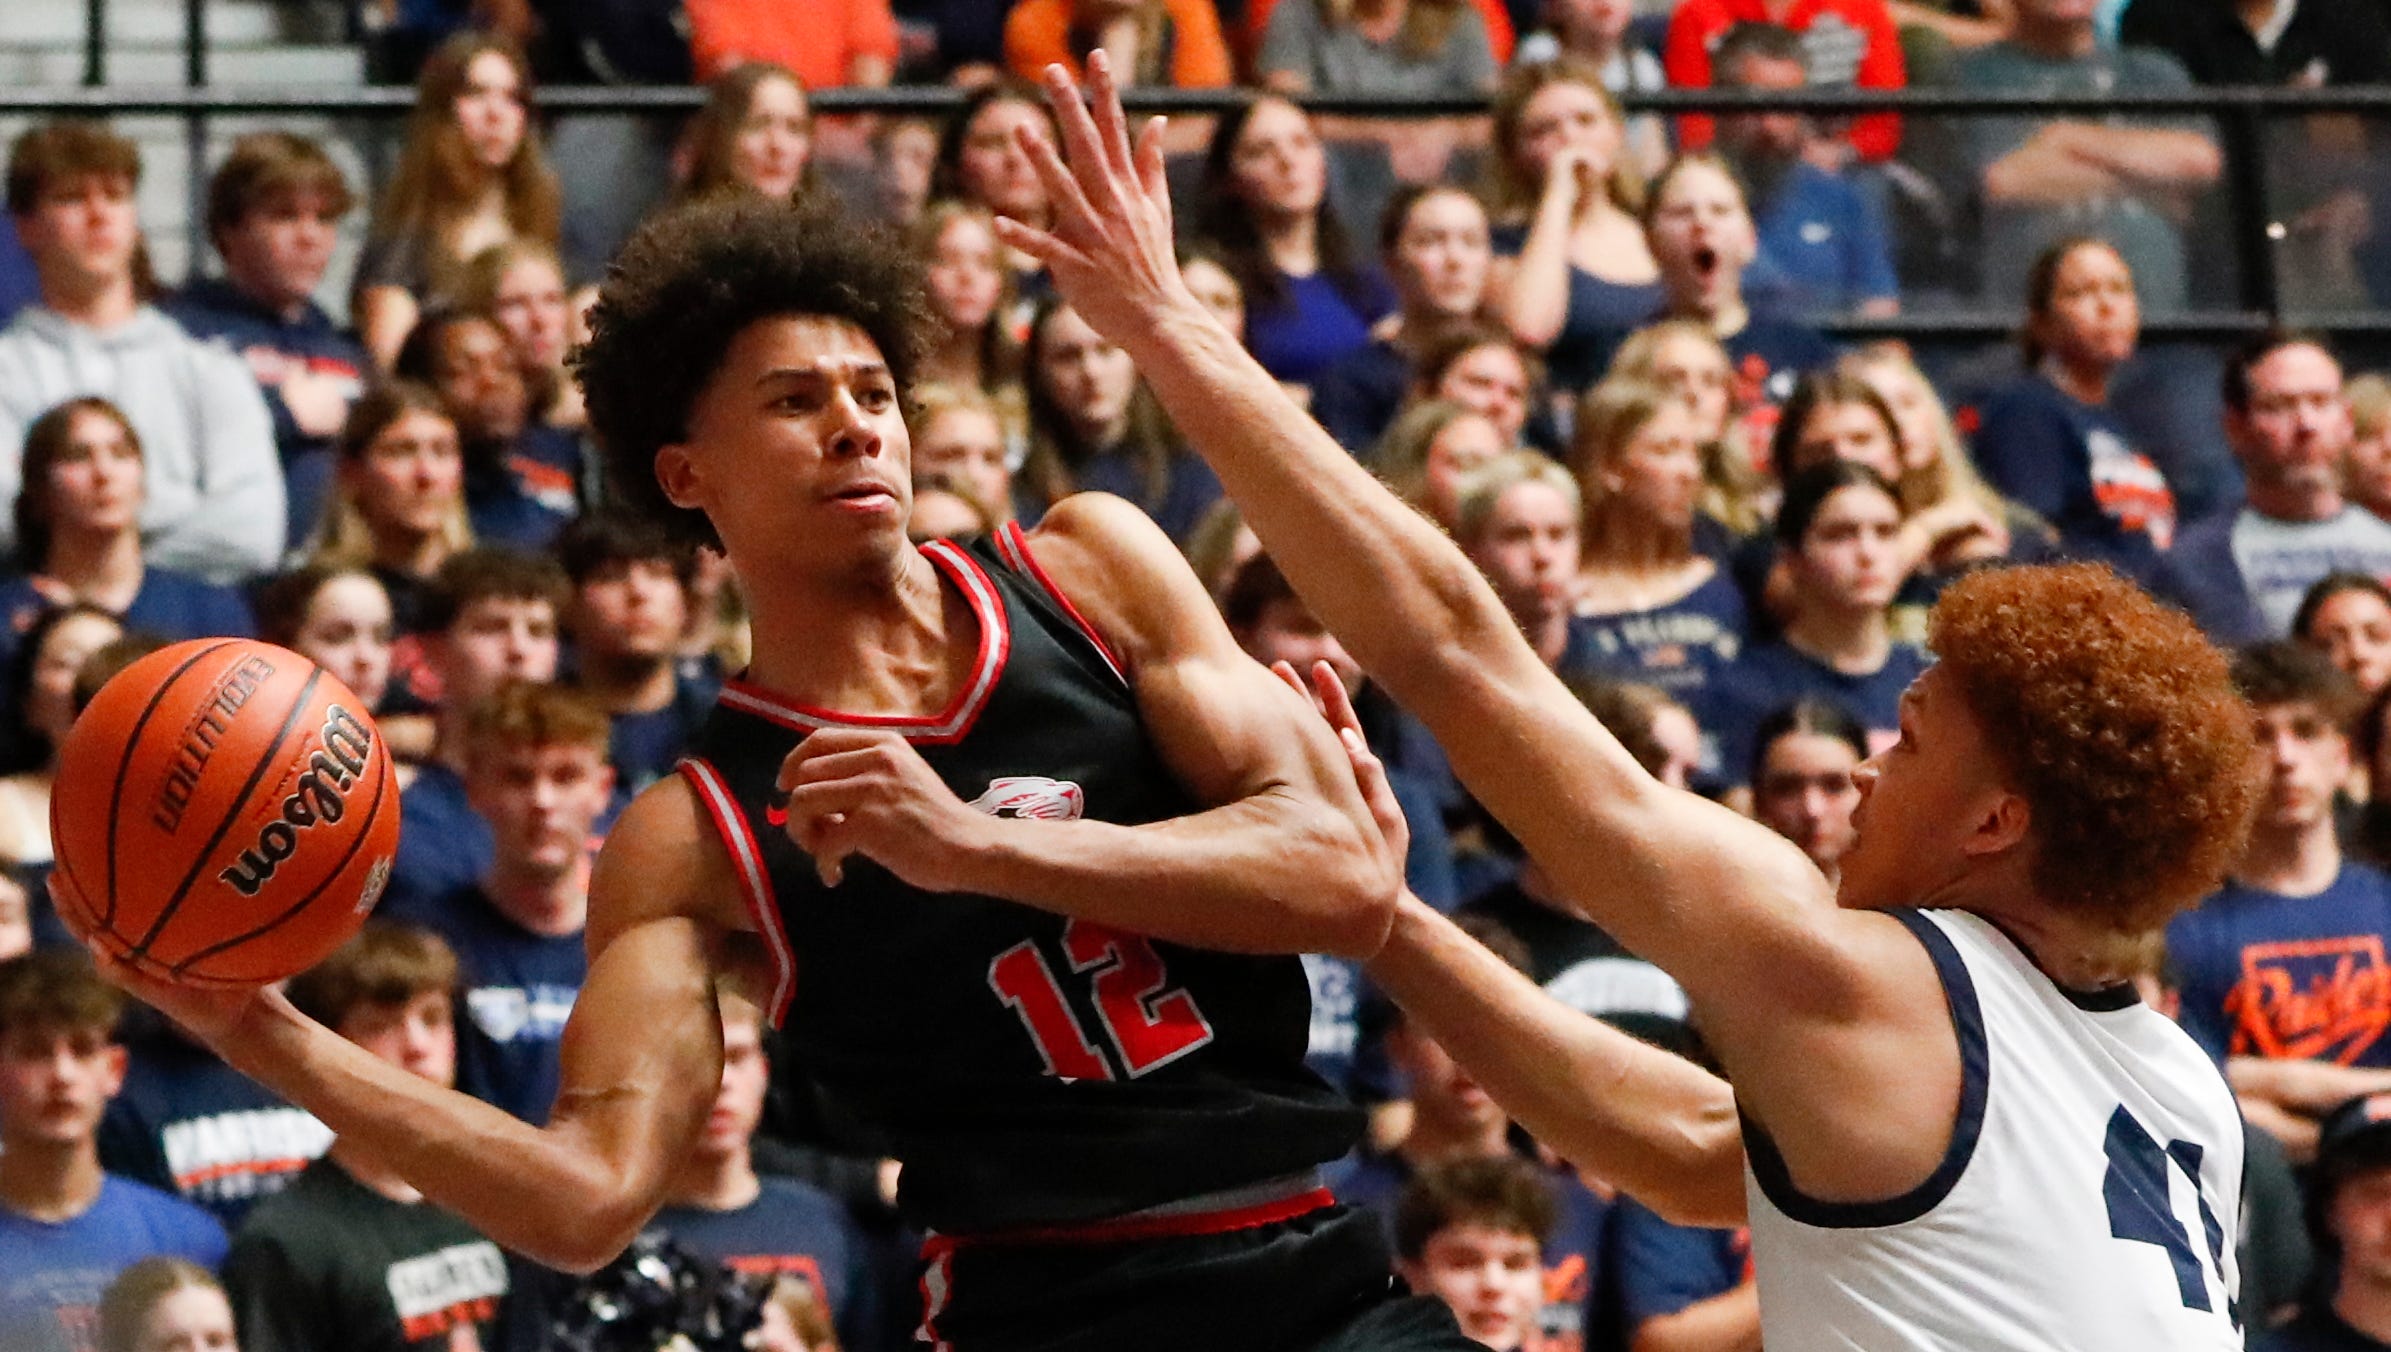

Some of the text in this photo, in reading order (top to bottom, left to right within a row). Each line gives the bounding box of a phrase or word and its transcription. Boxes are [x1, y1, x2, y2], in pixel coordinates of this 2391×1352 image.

[153, 656, 275, 836] EVOLUTION
[217, 703, 373, 897] Wilson
[986, 912, 1215, 1084] 12
